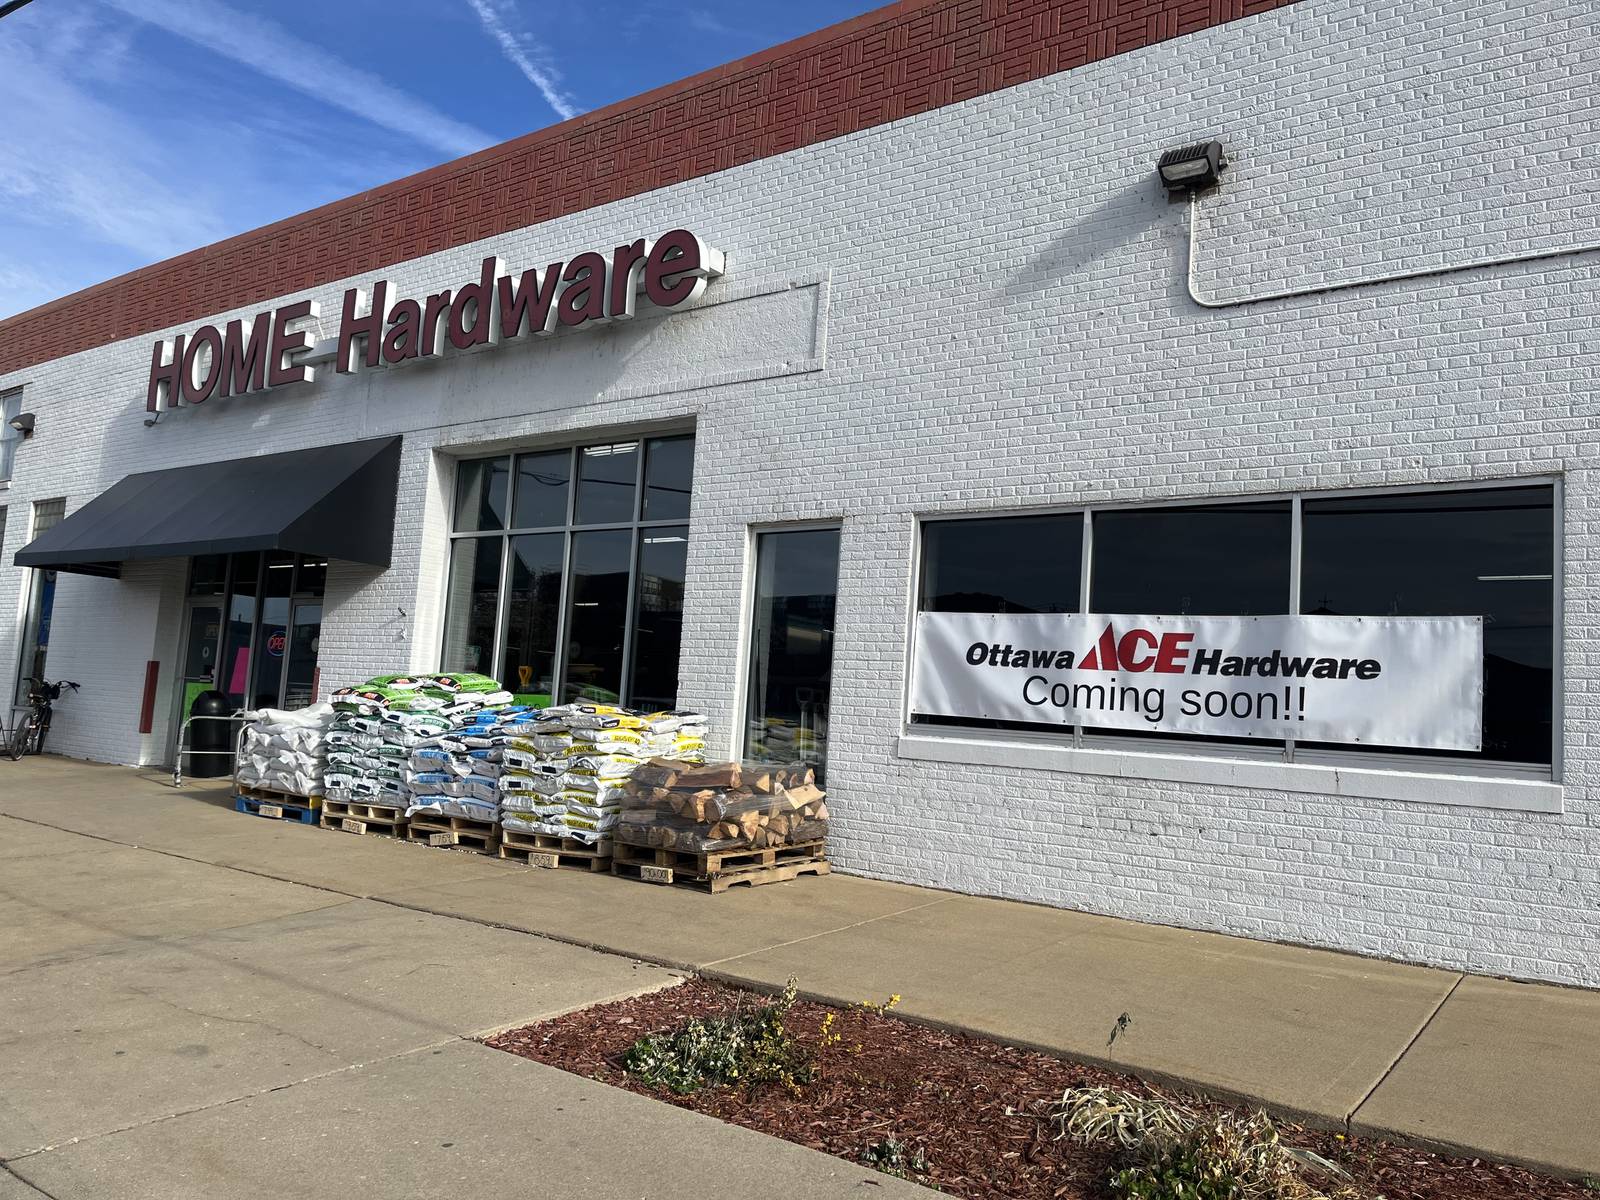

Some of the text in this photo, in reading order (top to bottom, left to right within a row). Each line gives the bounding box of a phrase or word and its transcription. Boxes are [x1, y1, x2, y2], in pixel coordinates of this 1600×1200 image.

[147, 228, 703, 413] HOME Hardware
[270, 636, 287, 650] OPE
[966, 621, 1381, 680] Ottawa ACE Hardware
[1022, 675, 1306, 722] Coming soon!!
